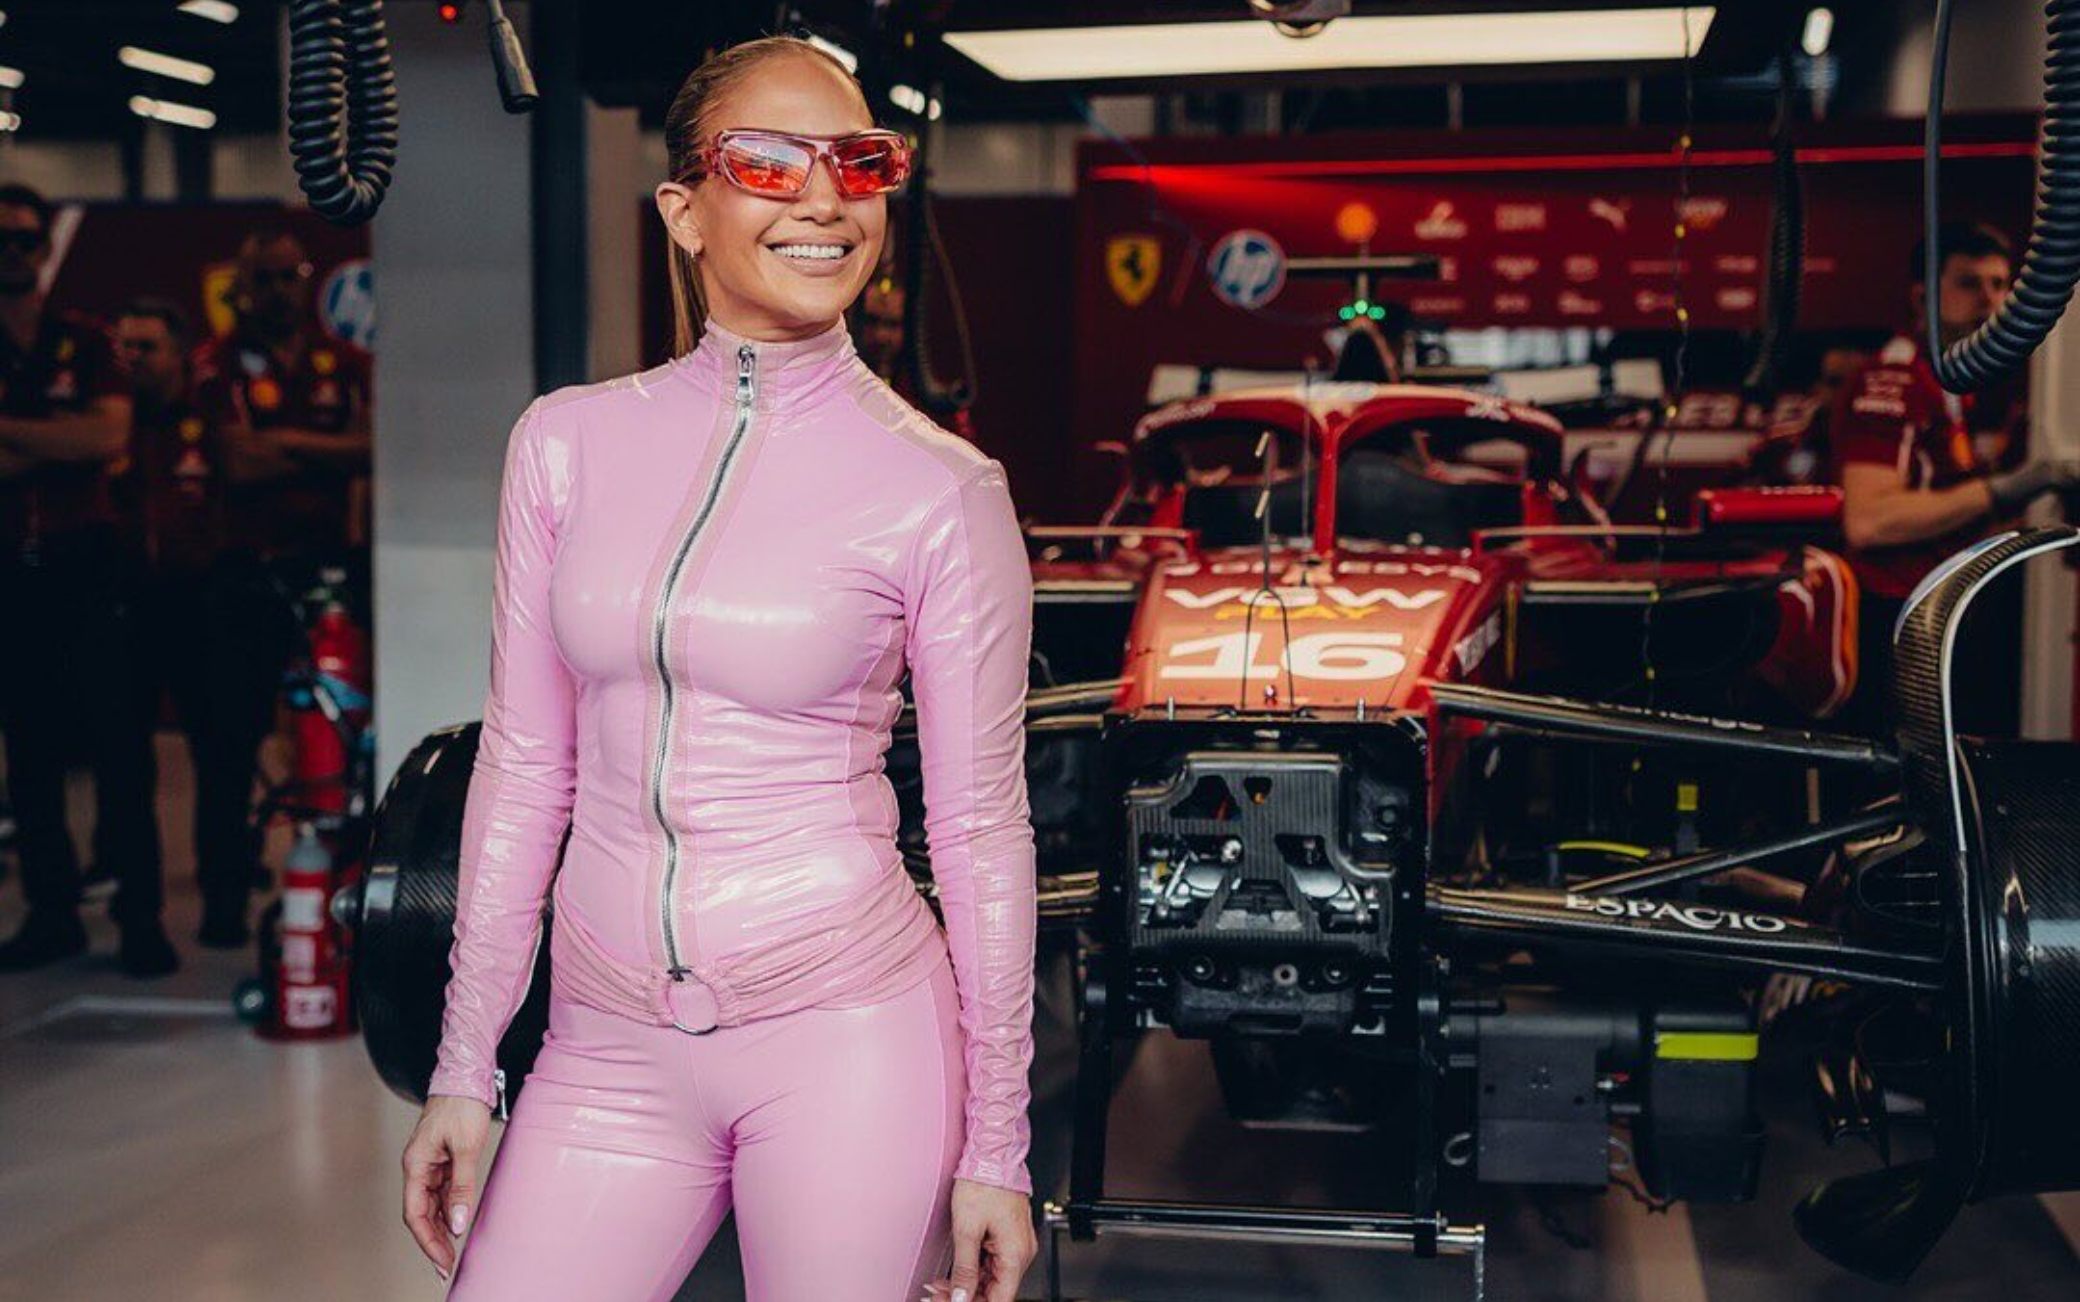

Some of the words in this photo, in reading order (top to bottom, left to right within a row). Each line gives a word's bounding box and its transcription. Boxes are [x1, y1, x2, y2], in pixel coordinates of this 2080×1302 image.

[1211, 230, 1280, 308] hp
[1160, 632, 1407, 680] 16
[1565, 894, 1786, 933] ESPACIO
